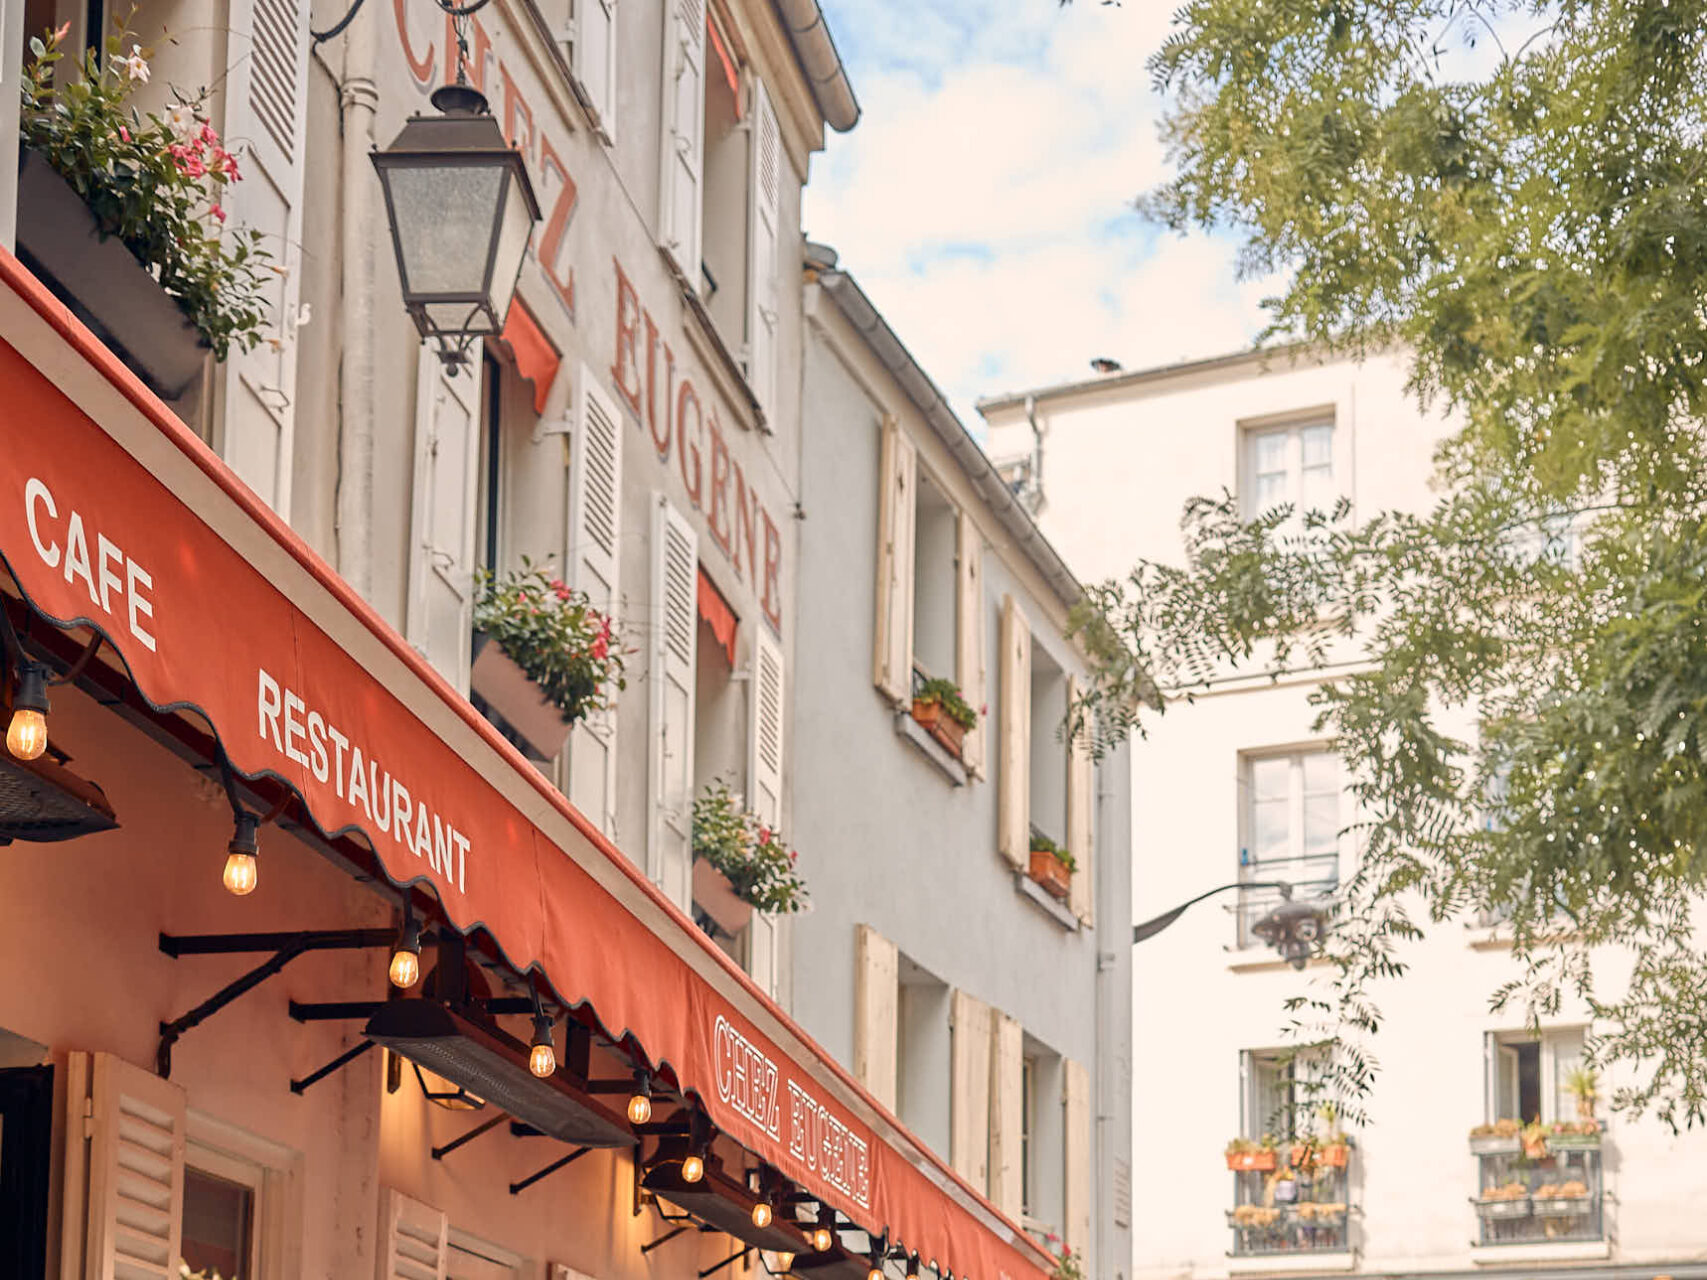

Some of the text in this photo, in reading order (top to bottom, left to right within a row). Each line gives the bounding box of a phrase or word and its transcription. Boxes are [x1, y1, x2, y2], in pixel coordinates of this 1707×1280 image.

[24, 477, 156, 652] CAFE
[258, 668, 471, 894] RESTAURANT
[714, 1014, 780, 1143] CHEZ
